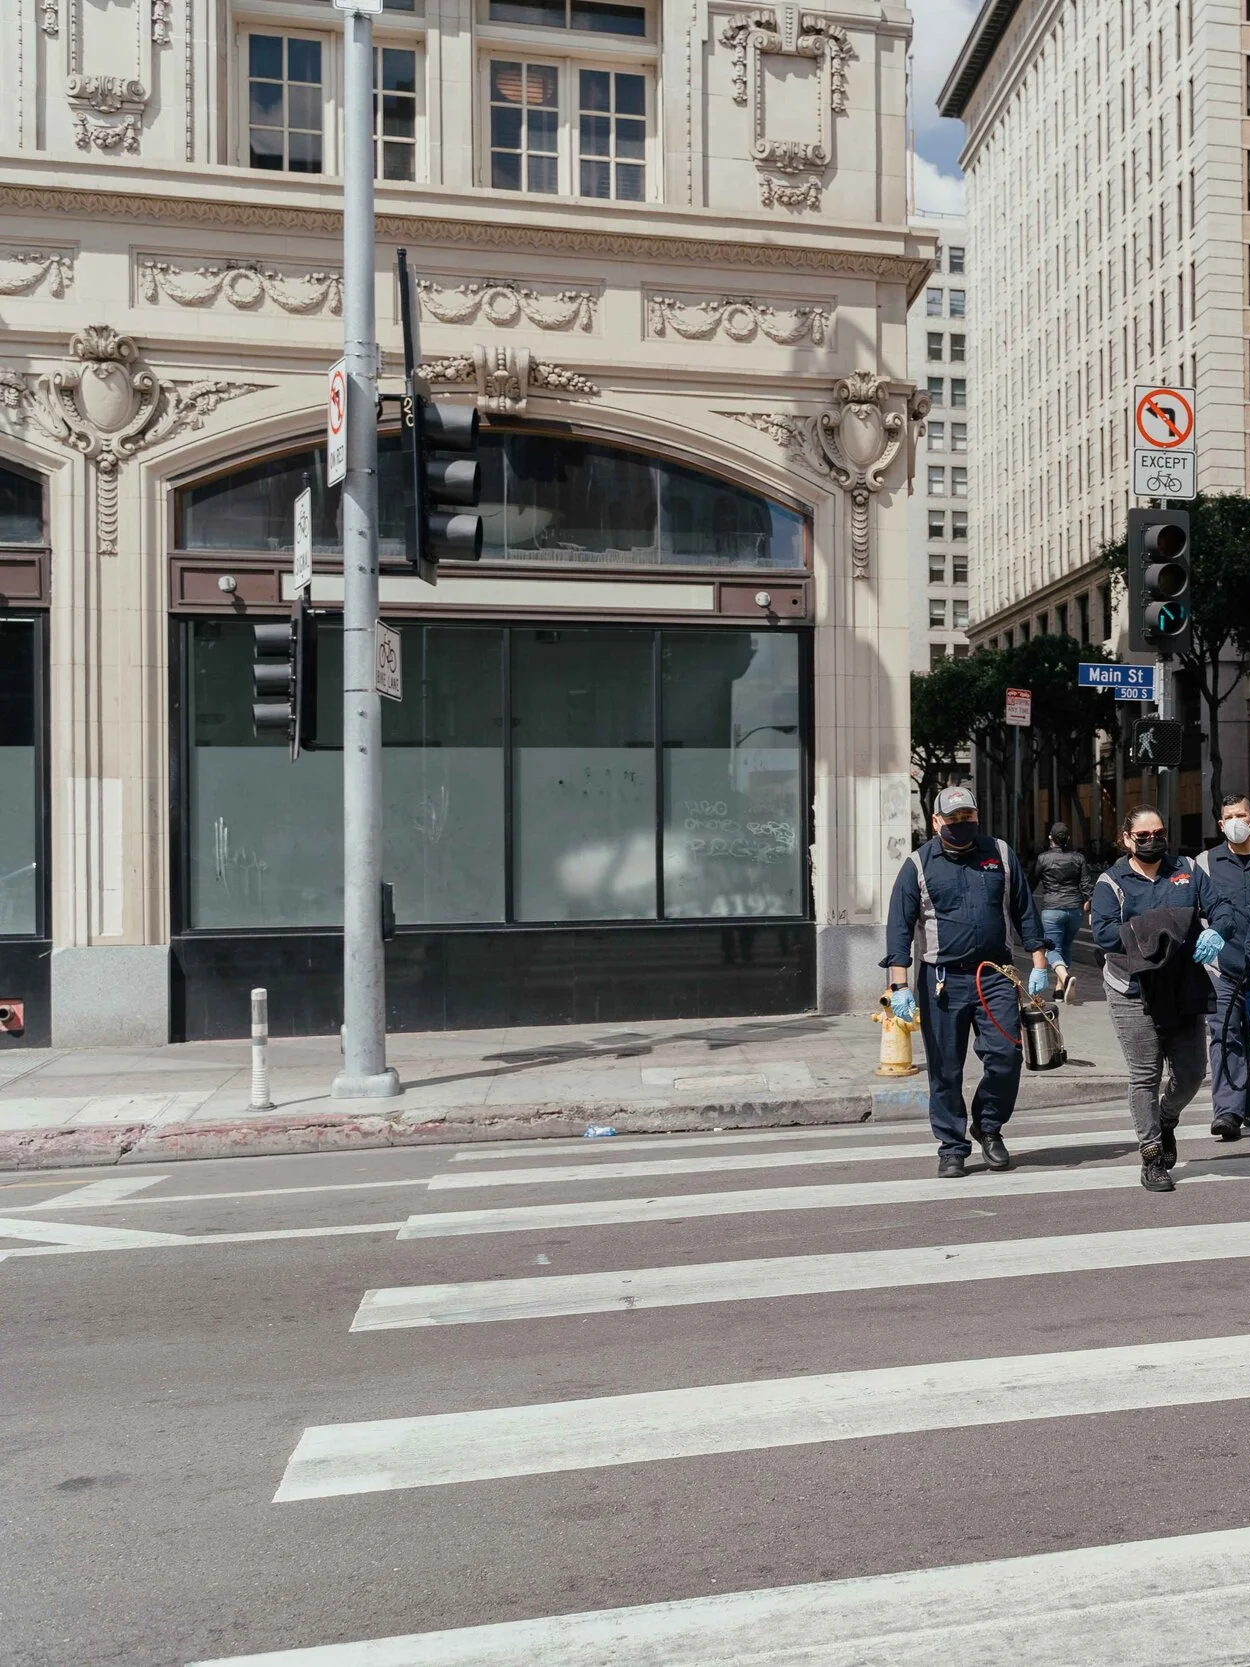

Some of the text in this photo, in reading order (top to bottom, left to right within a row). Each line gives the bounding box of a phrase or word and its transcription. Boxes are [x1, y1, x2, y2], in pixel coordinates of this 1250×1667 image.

[1141, 455, 1188, 470] EXCEPT
[377, 670, 399, 692] BIKE LANE
[1089, 668, 1143, 683] Main St
[1121, 688, 1148, 699] 500 S
